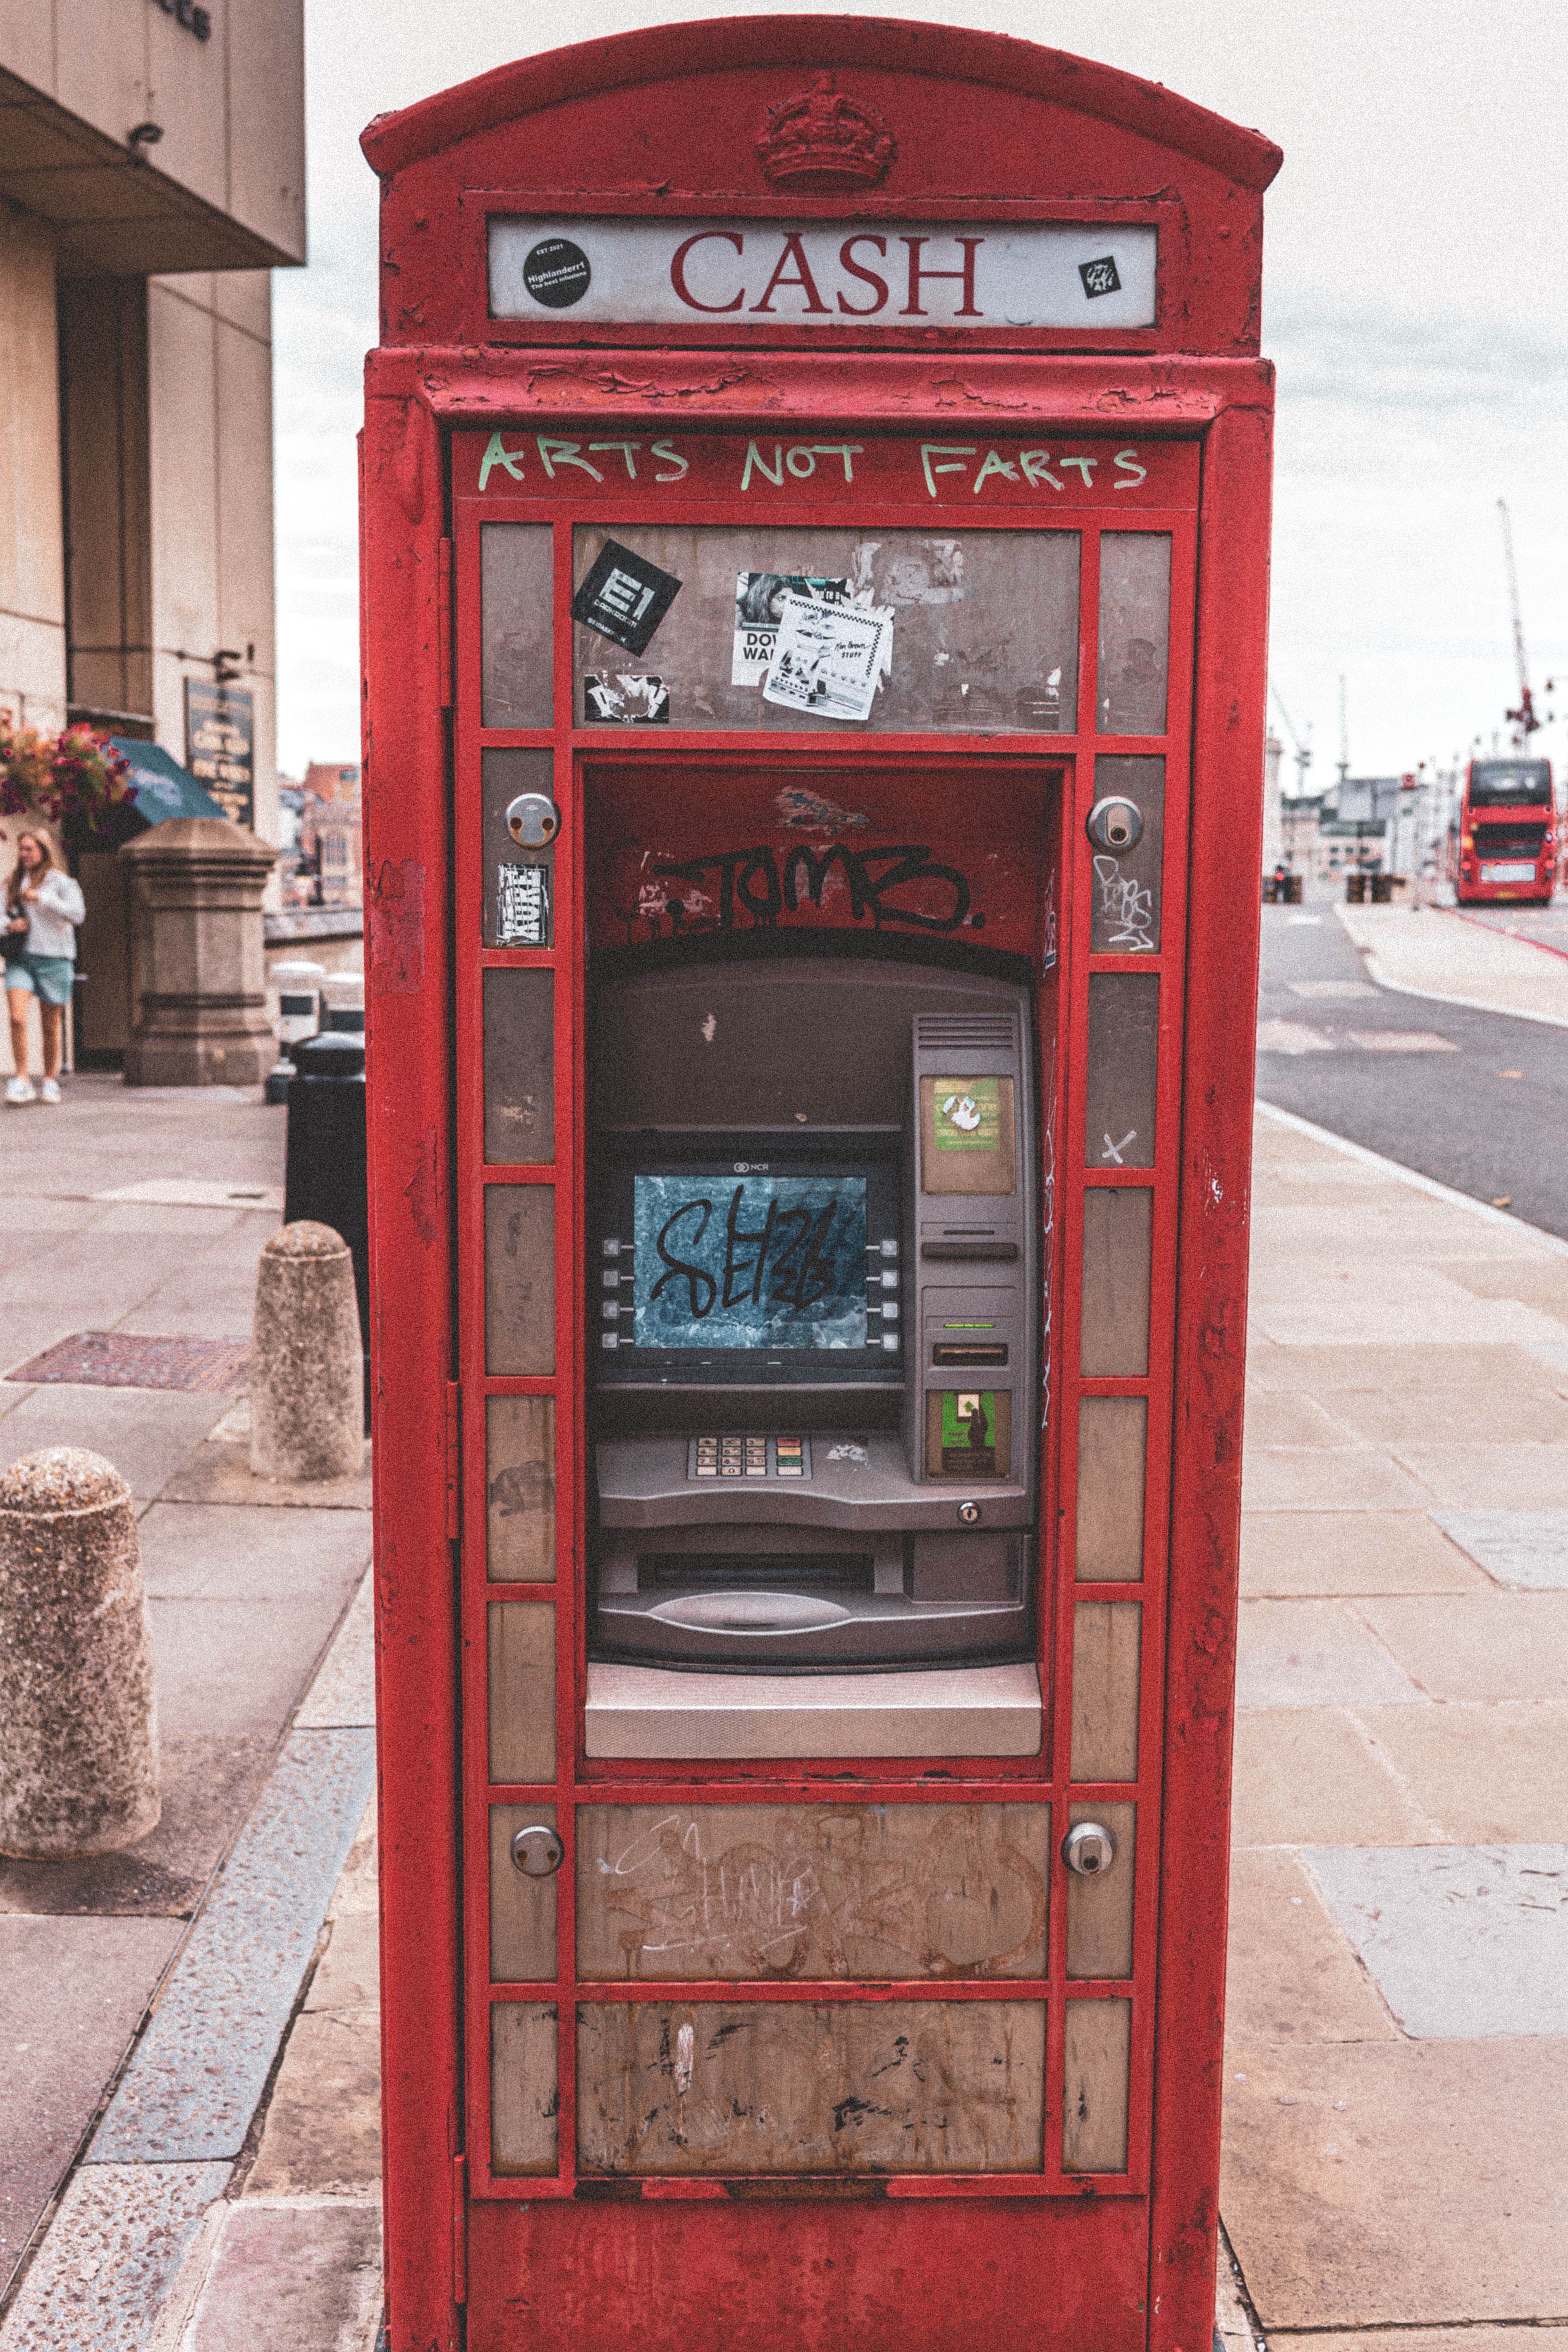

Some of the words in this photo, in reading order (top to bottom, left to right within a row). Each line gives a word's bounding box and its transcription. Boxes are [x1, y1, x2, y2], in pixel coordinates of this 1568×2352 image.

[544, 278, 558, 287] best
[559, 271, 587, 282] infusions
[670, 231, 984, 317] CASH
[478, 432, 689, 490] ARTS
[741, 441, 863, 490] NOT
[920, 442, 1148, 497] FARTS
